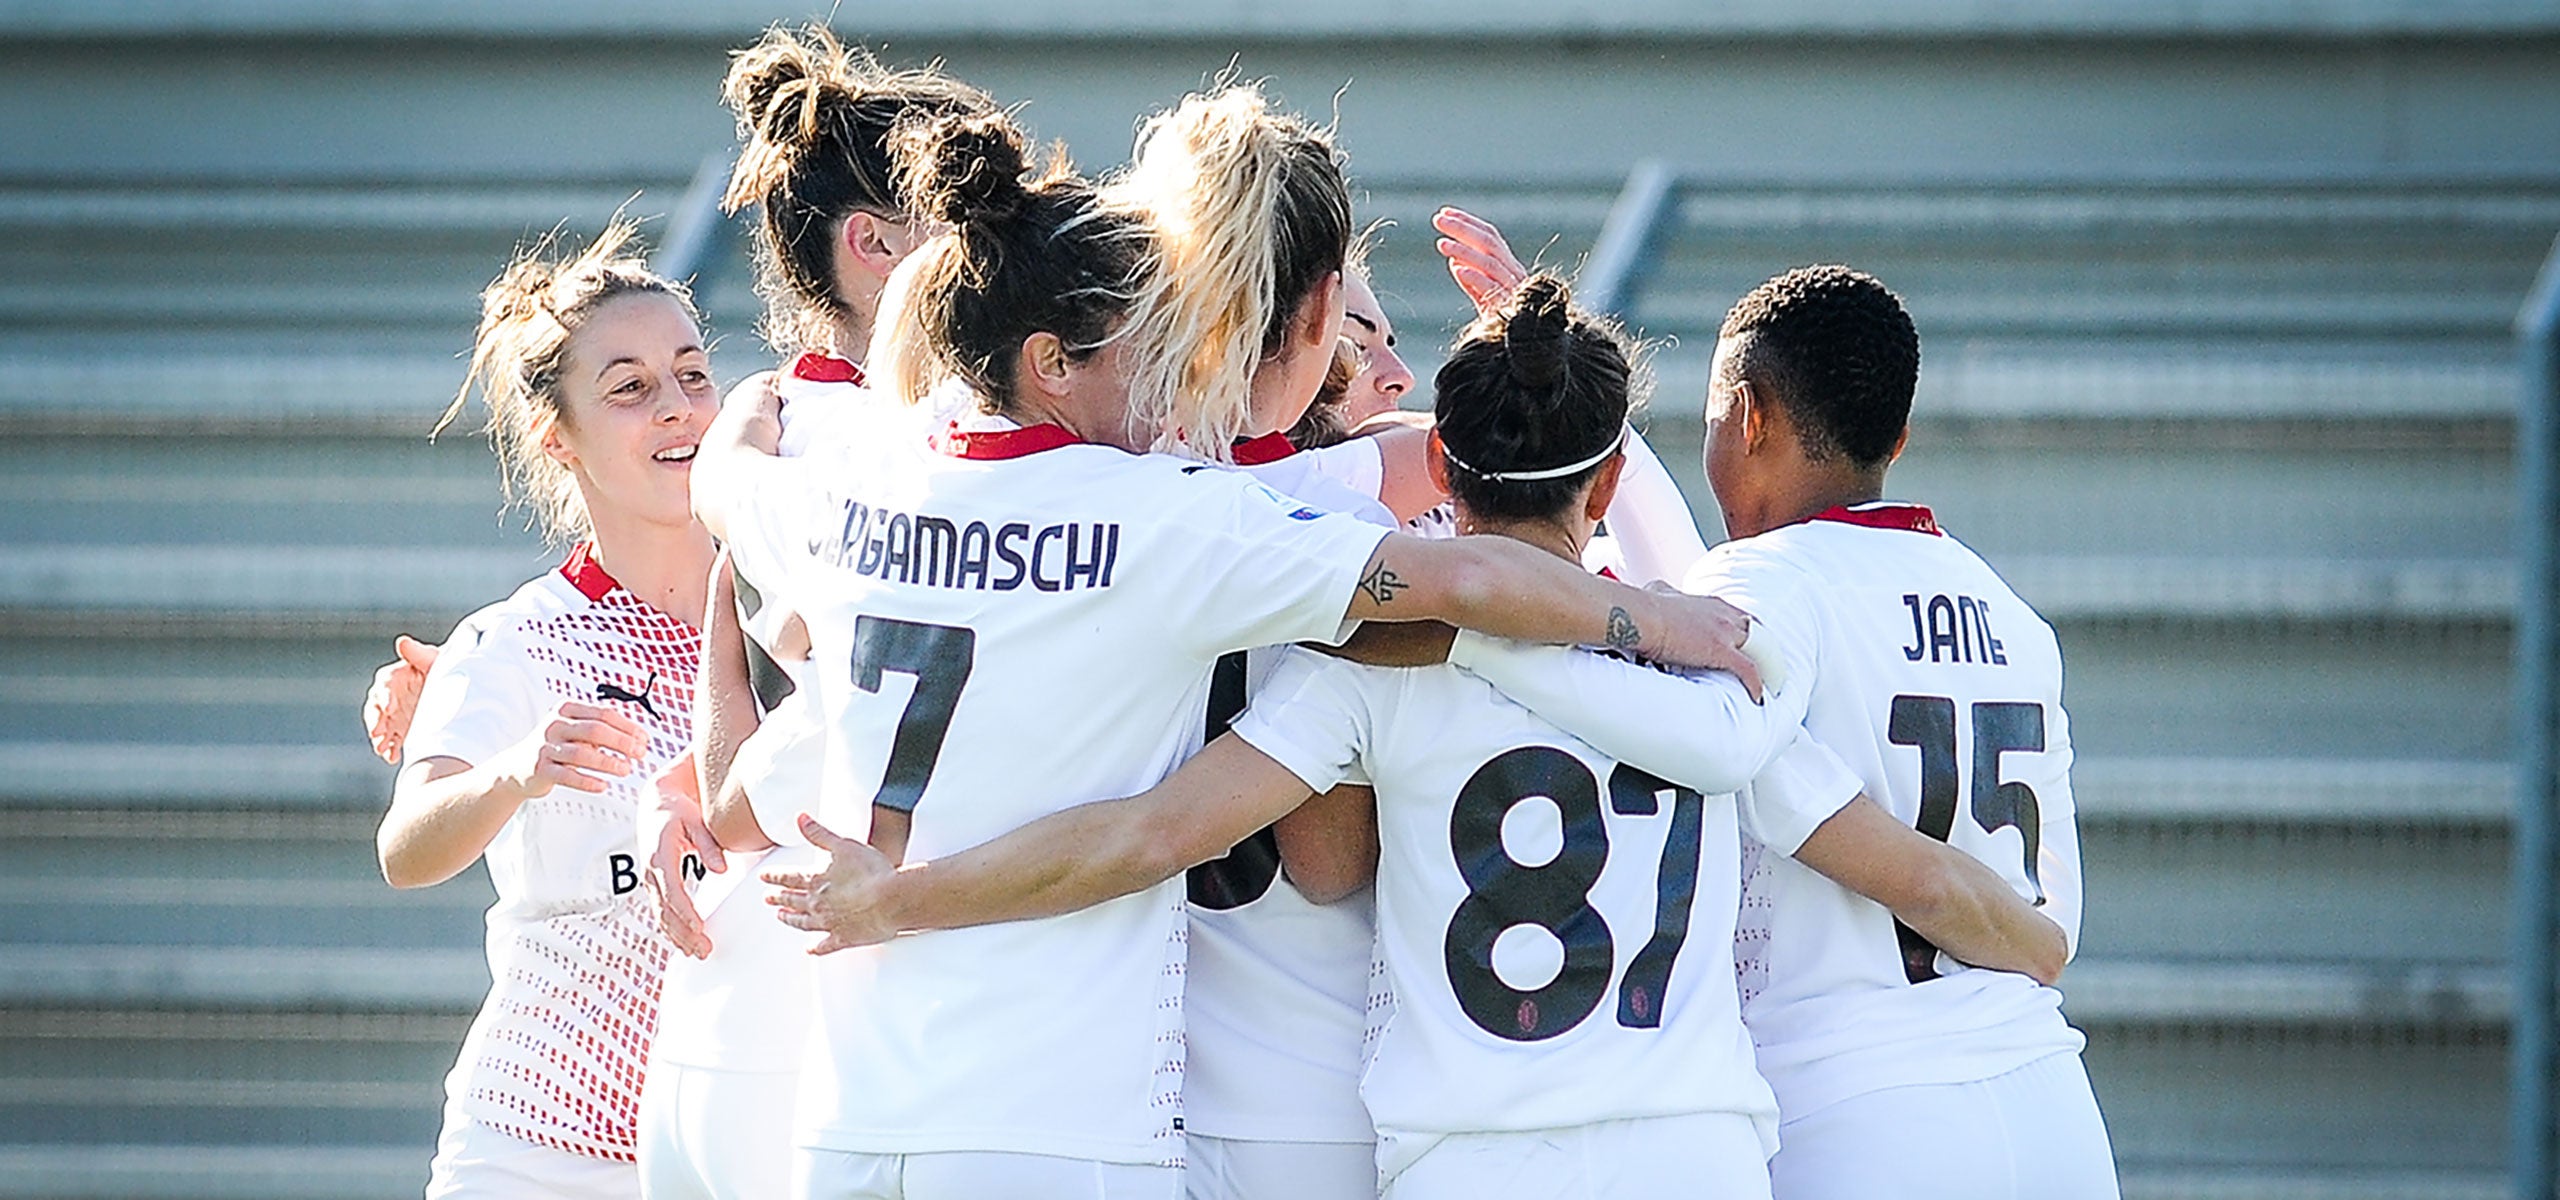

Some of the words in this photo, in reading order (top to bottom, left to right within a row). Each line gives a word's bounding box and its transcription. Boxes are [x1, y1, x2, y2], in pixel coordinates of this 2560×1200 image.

[807, 497, 1119, 592] RGAMASCHI
[1902, 594, 2008, 666] JANE
[851, 614, 976, 866] 7
[1445, 746, 1703, 1040] 87
